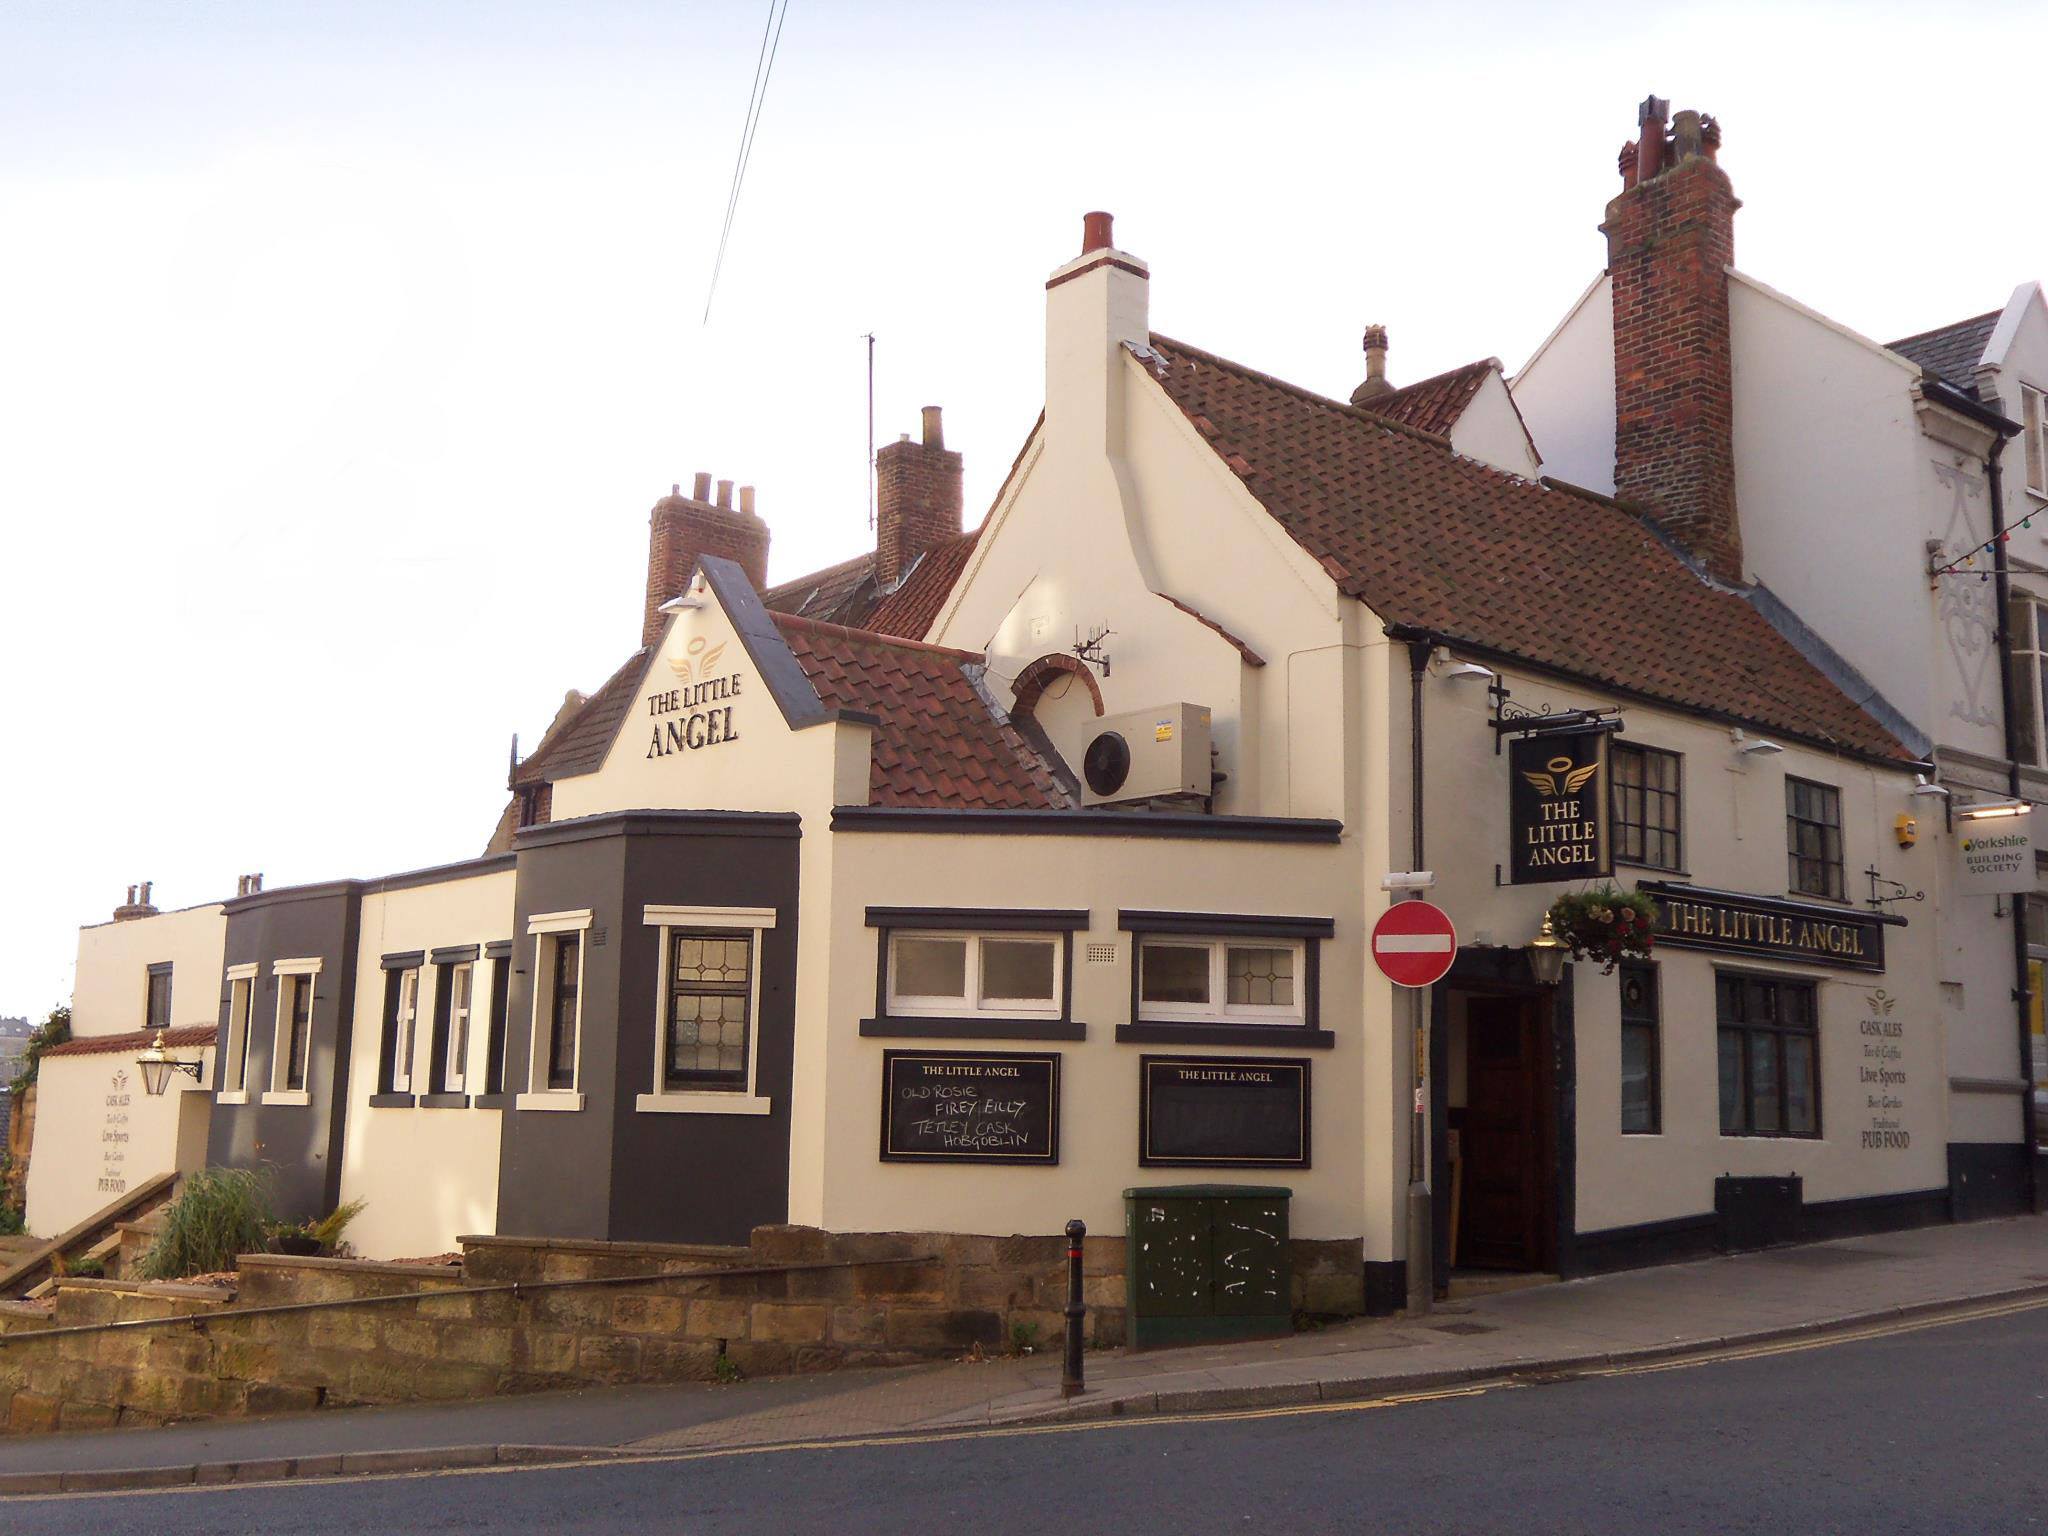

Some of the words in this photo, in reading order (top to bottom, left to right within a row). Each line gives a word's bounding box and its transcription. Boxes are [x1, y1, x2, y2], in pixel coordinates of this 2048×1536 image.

[648, 689, 680, 716] THE
[683, 673, 741, 708] LITTLE
[646, 706, 739, 758] ANGEL
[1541, 800, 1580, 820] THE
[1528, 821, 1595, 844] LITTLE
[1969, 835, 2028, 853] Yorkshire
[1528, 844, 1596, 866] ANGEL
[1967, 853, 2023, 864] BUILDING
[1970, 863, 2020, 874] SOCIETY
[1666, 901, 1713, 935] THE
[1719, 909, 1793, 945] LITTLE
[1799, 921, 1864, 955] ANGEL
[1860, 1020, 1882, 1036] CASK
[1883, 1022, 1903, 1038] ALES
[922, 1066, 943, 1076] THE
[946, 1066, 982, 1076] LITTLE
[985, 1067, 1020, 1077] ANGEL
[1179, 1070, 1200, 1080] THE
[1201, 1071, 1236, 1081] LITTLE
[1239, 1072, 1273, 1082] ANGEL
[1860, 1066, 1877, 1083] Live
[1879, 1067, 1906, 1088] Sports
[902, 1087, 931, 1099] OLD
[933, 1084, 978, 1099] ROSIE
[935, 1101, 978, 1116] FIREY
[912, 1119, 969, 1136] TETLEY
[976, 1121, 1017, 1136] CASK
[1862, 1130, 1882, 1149] PUB
[1884, 1130, 1910, 1149] FOOD
